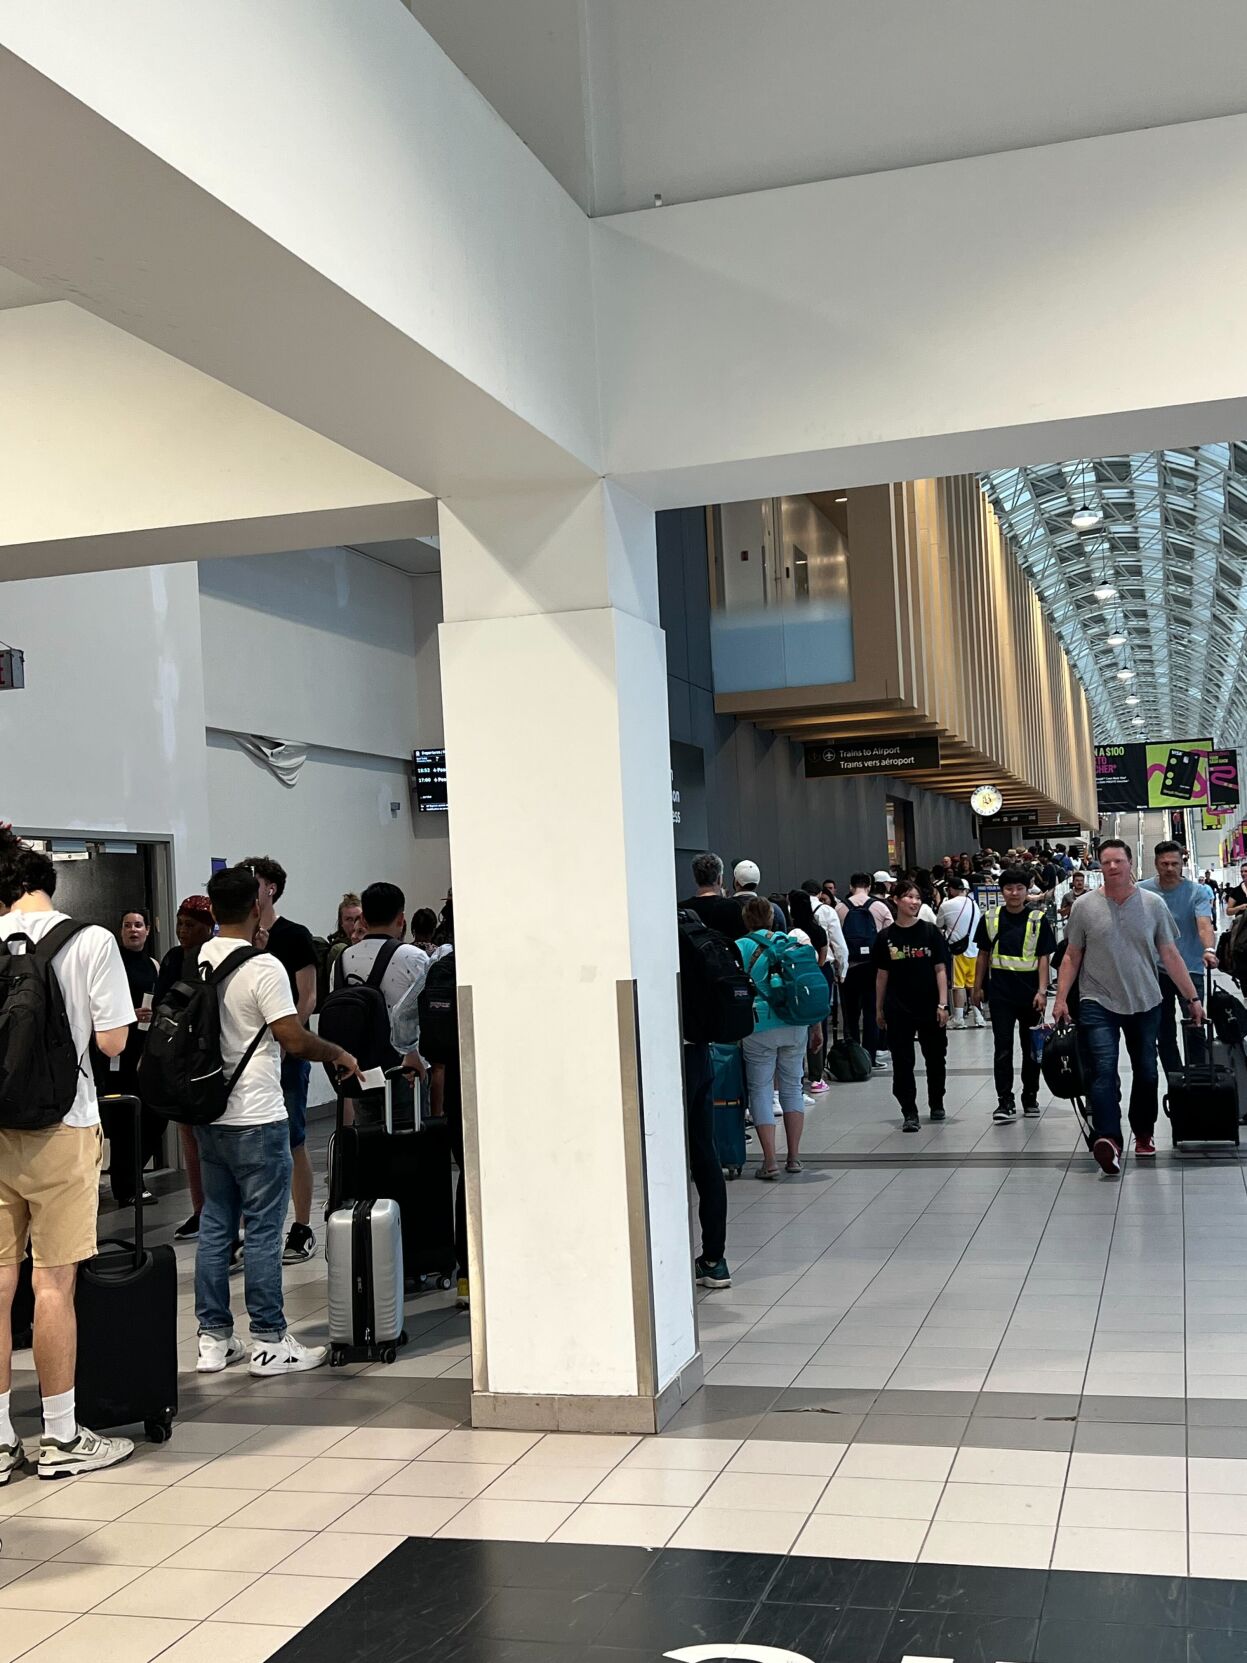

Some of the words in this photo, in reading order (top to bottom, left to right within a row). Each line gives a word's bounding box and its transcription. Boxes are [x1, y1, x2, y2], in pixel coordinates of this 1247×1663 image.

[840, 750, 862, 758] Trains
[872, 746, 900, 756] Airport
[1099, 747, 1105, 757] A
[1105, 746, 1125, 757] $100
[840, 761, 862, 769] Trains
[881, 756, 915, 766] aéroport
